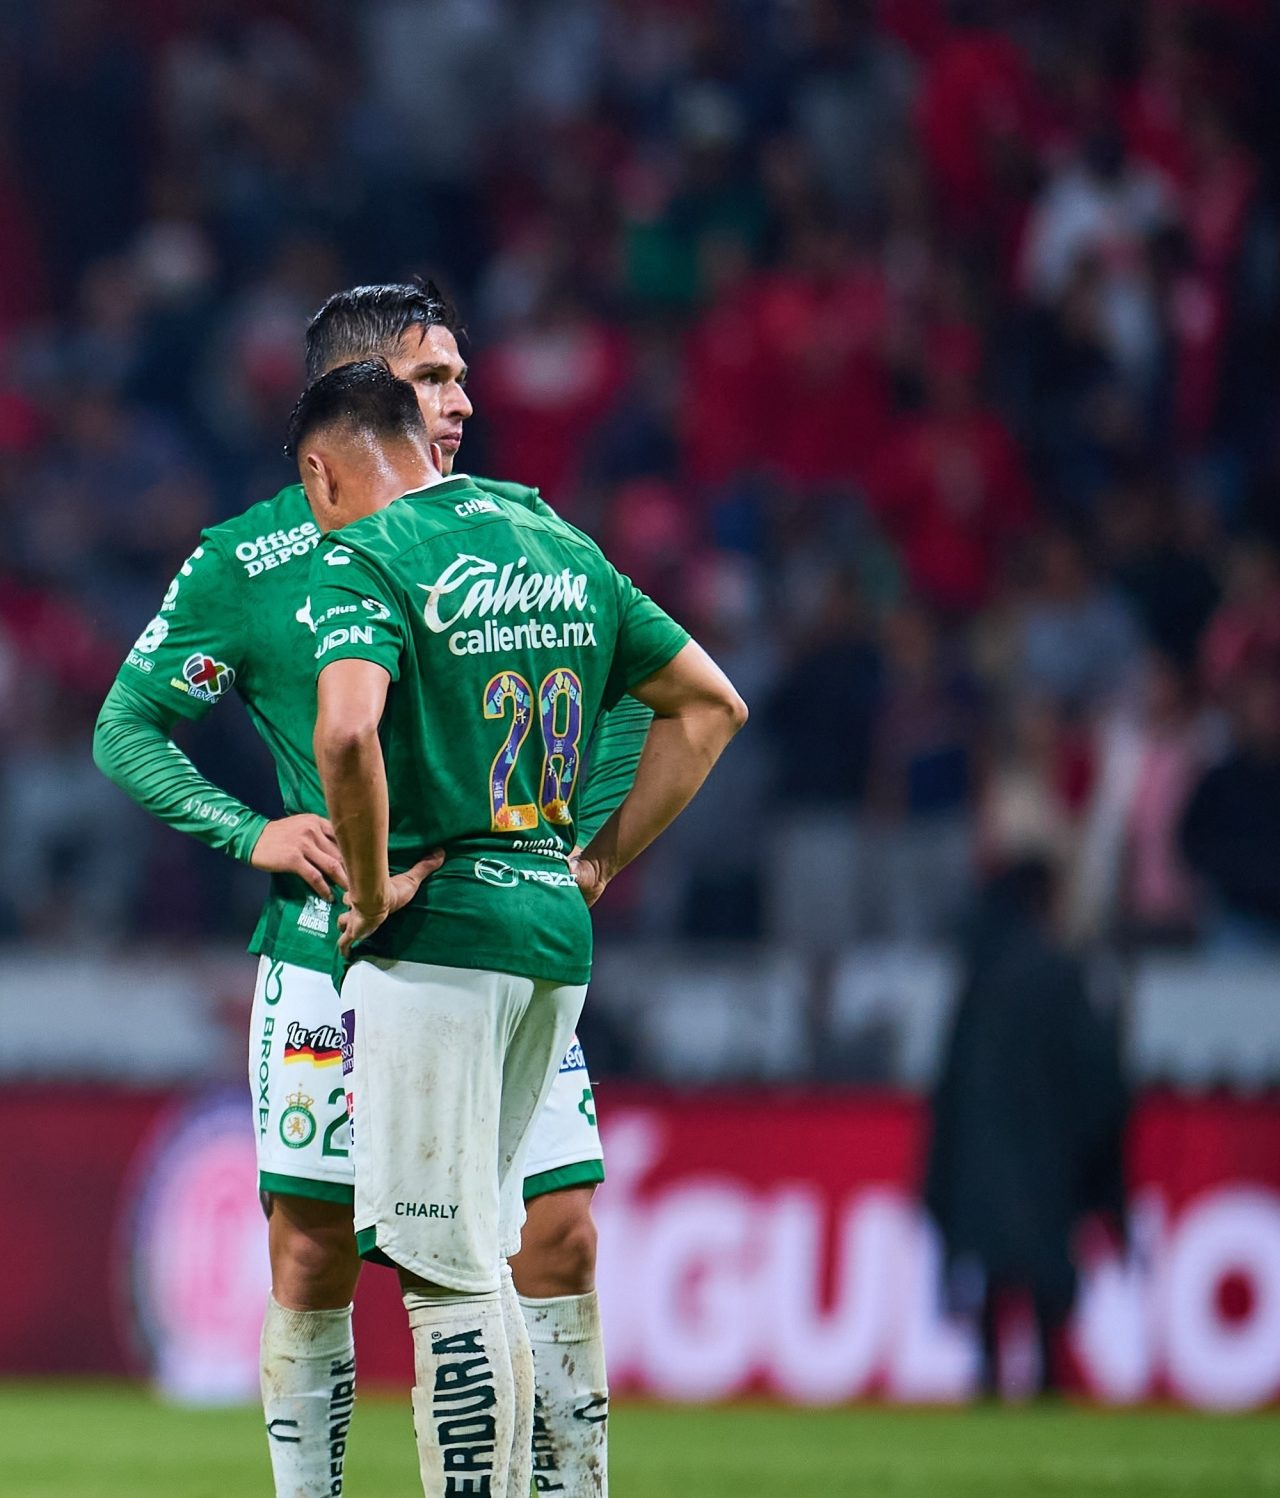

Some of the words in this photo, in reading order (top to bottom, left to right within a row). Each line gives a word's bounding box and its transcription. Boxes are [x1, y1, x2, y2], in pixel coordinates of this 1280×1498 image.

[235, 521, 317, 562] Office
[243, 532, 321, 579] DEPOT
[326, 604, 358, 619] Plus
[416, 553, 588, 634] Caliente
[448, 618, 597, 656] caliente.mx
[287, 1021, 308, 1050] La
[394, 1202, 459, 1219] CHARLY
[431, 1328, 499, 1498] ERDURA
